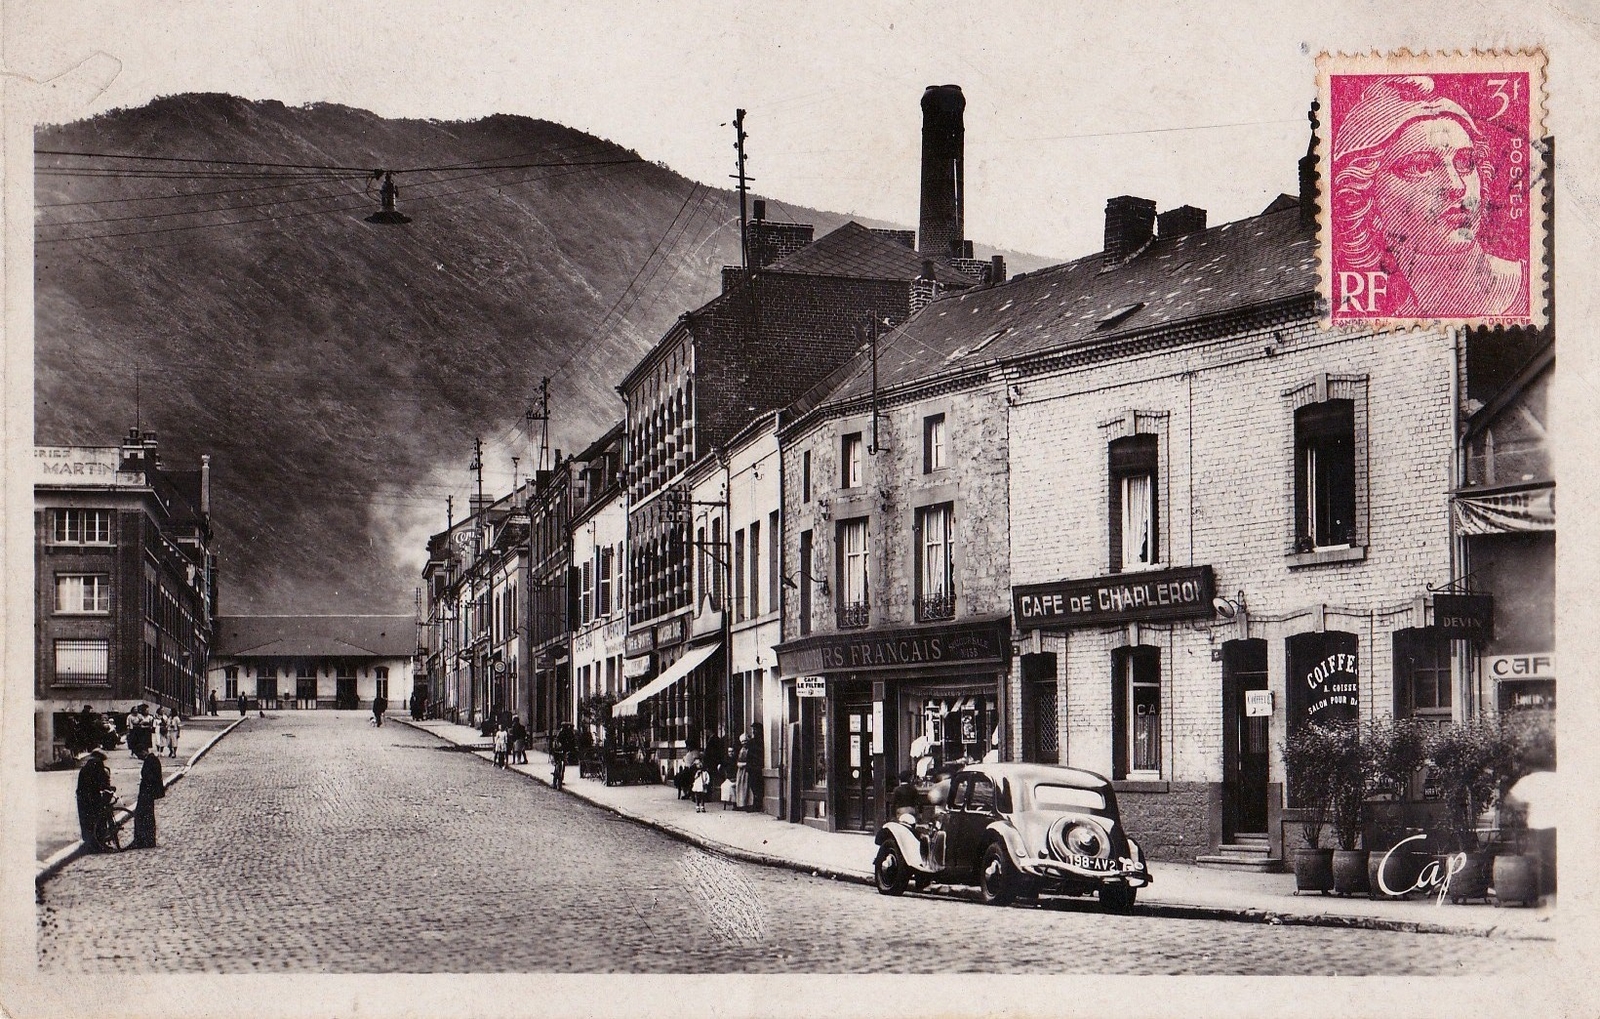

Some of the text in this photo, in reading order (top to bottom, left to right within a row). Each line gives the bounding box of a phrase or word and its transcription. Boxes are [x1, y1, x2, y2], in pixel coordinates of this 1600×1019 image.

[1510, 138, 1523, 220] POSTES
[1337, 271, 1388, 314] RF
[43, 462, 115, 475] MARTIN
[1021, 581, 1200, 617] CAFE DE CHARLEROI
[1307, 653, 1358, 690] COIFFE
[1308, 698, 1328, 715] SALON
[1330, 696, 1347, 705] POUR
